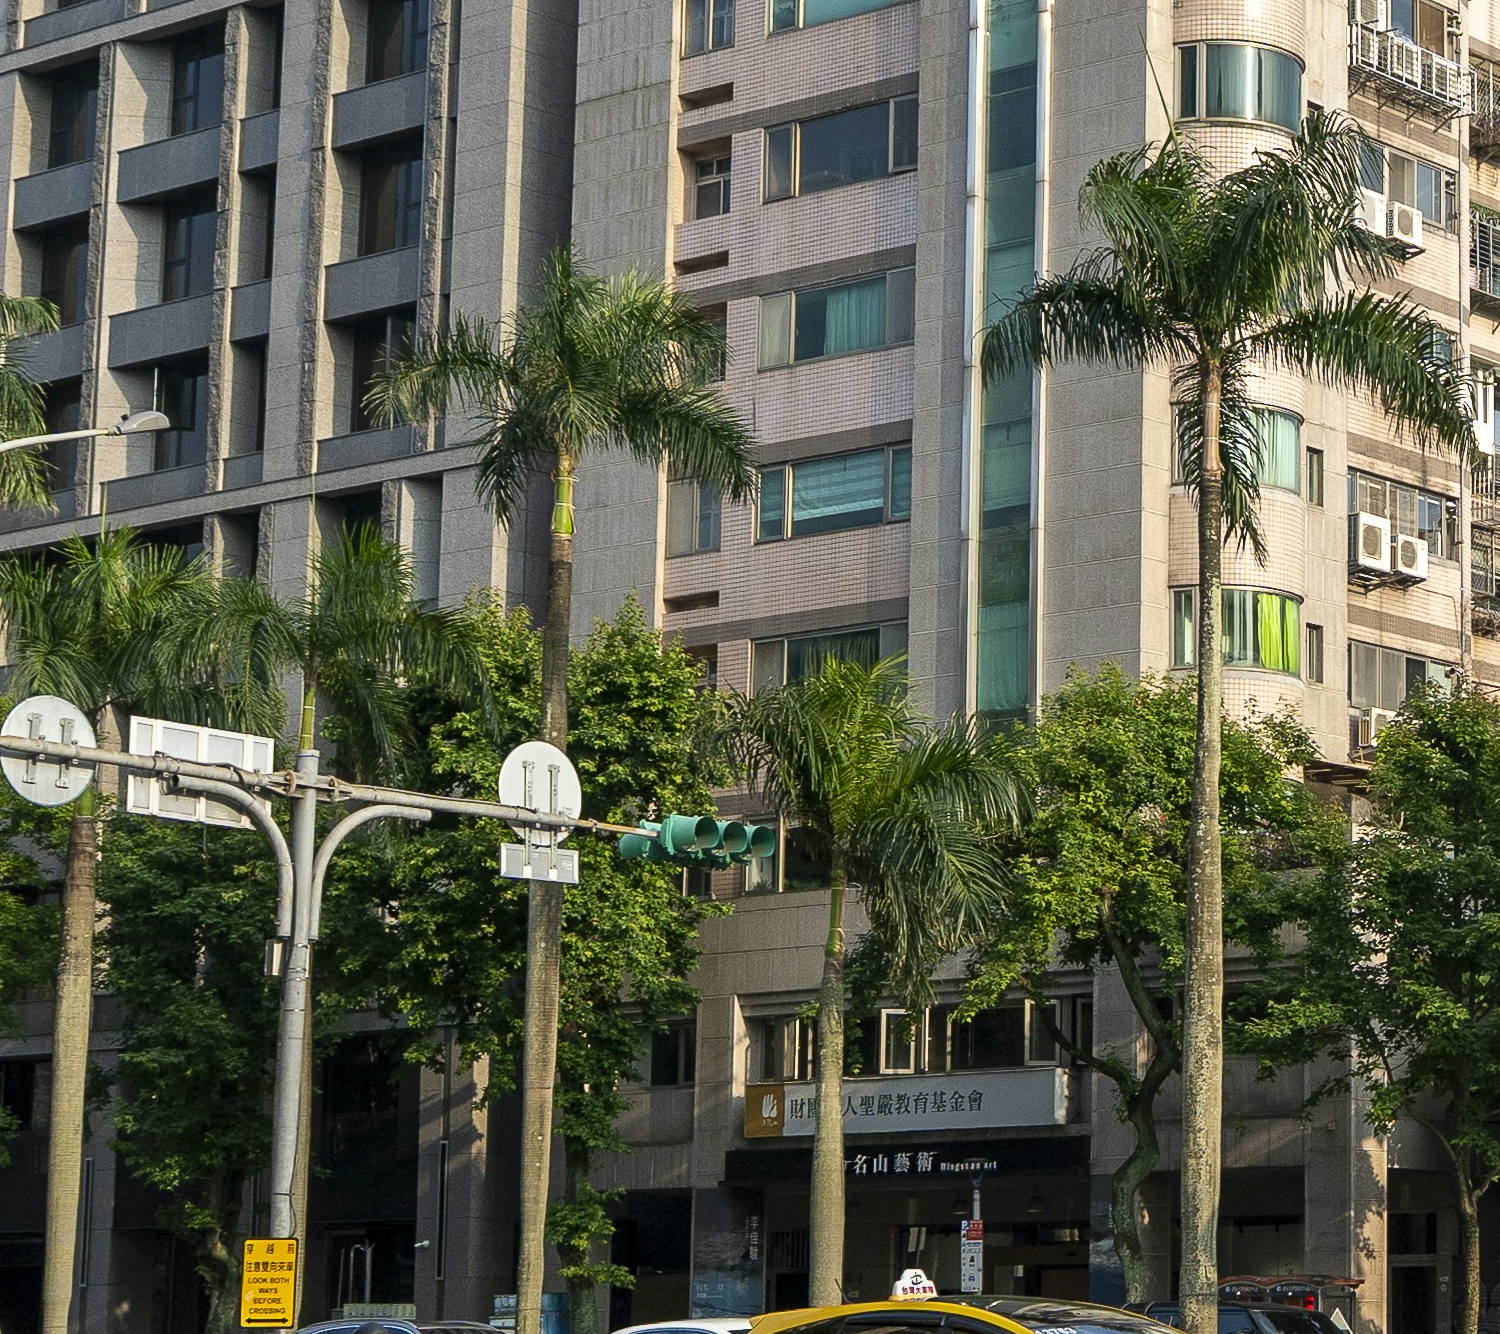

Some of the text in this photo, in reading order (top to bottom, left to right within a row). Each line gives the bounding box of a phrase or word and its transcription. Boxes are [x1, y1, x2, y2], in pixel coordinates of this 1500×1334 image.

[789, 1088, 985, 1120] 財團人聖嚴教育基金會
[253, 1297, 282, 1305] BEFORE
